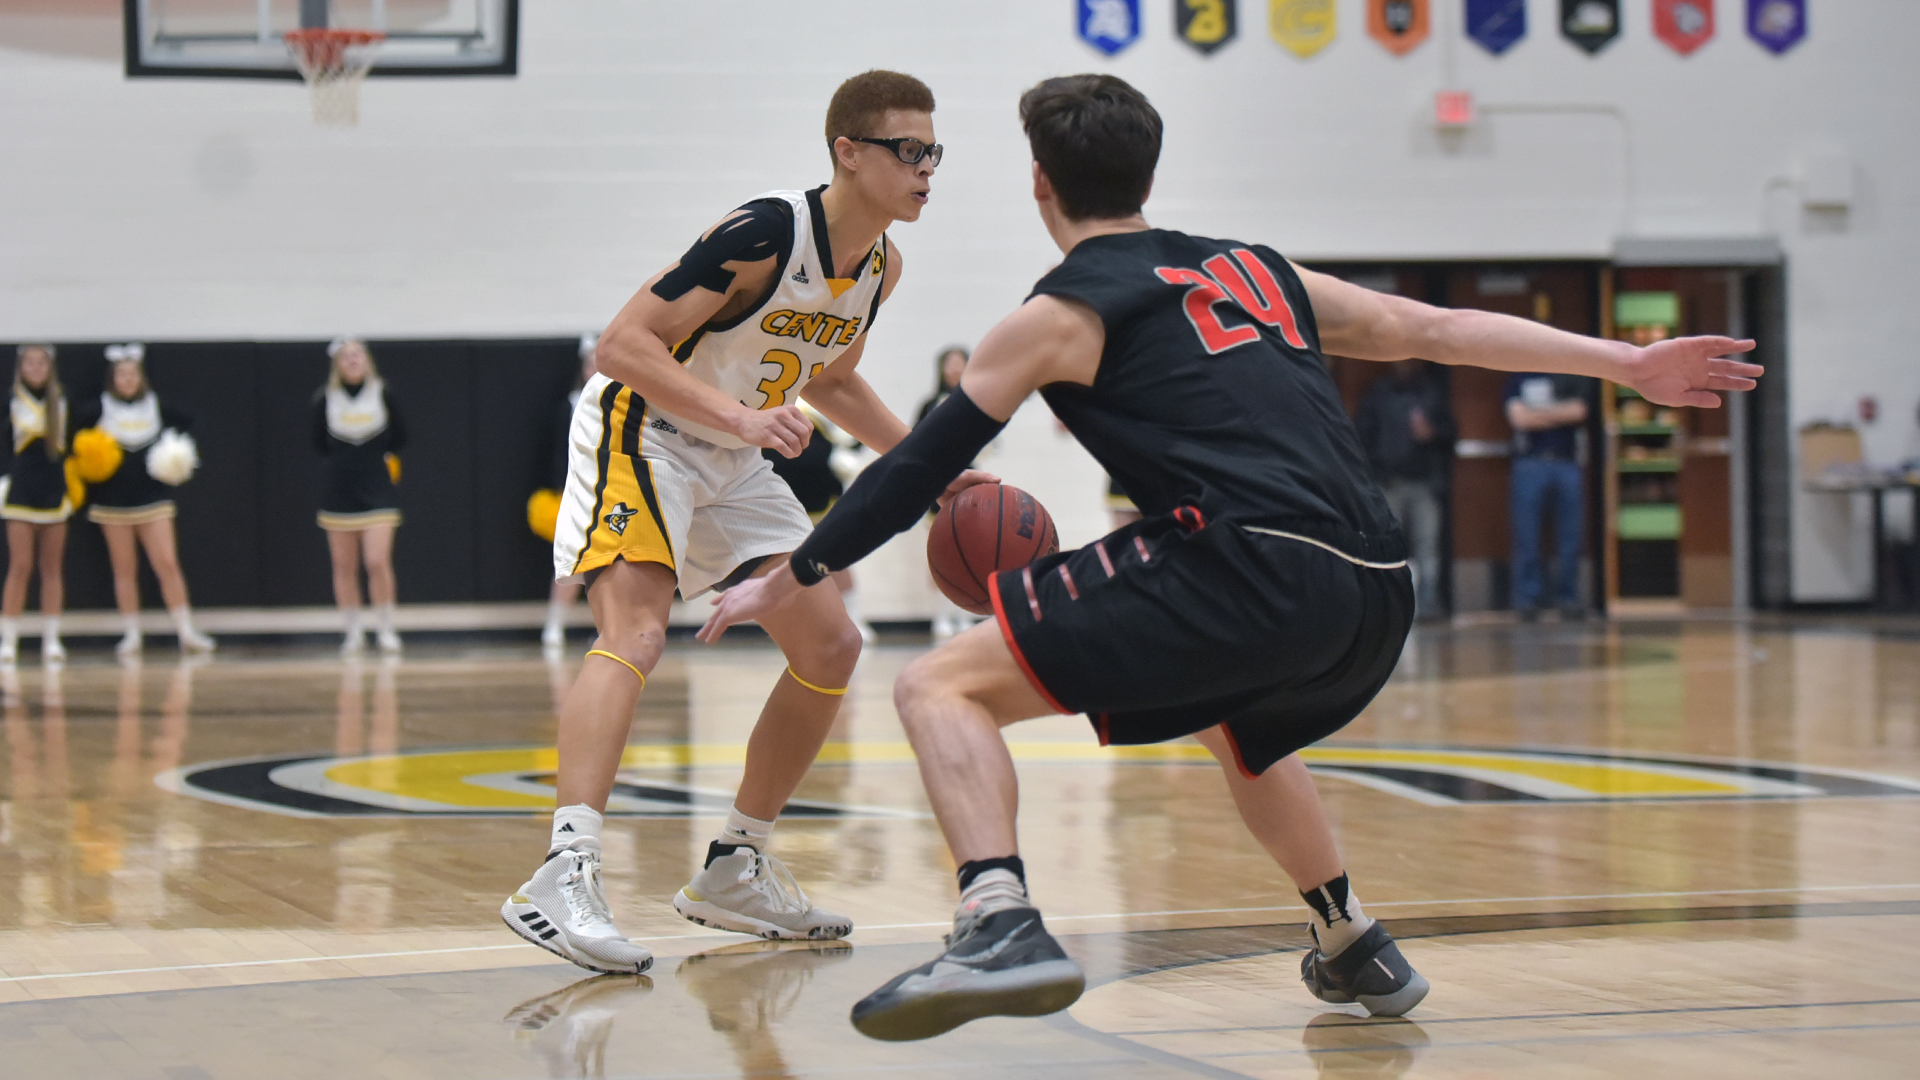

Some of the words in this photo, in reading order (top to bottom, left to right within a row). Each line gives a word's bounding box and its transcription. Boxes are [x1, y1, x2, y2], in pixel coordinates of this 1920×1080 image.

[1154, 249, 1308, 355] 24
[740, 349, 824, 411] 3
[651, 421, 678, 435] adidas
